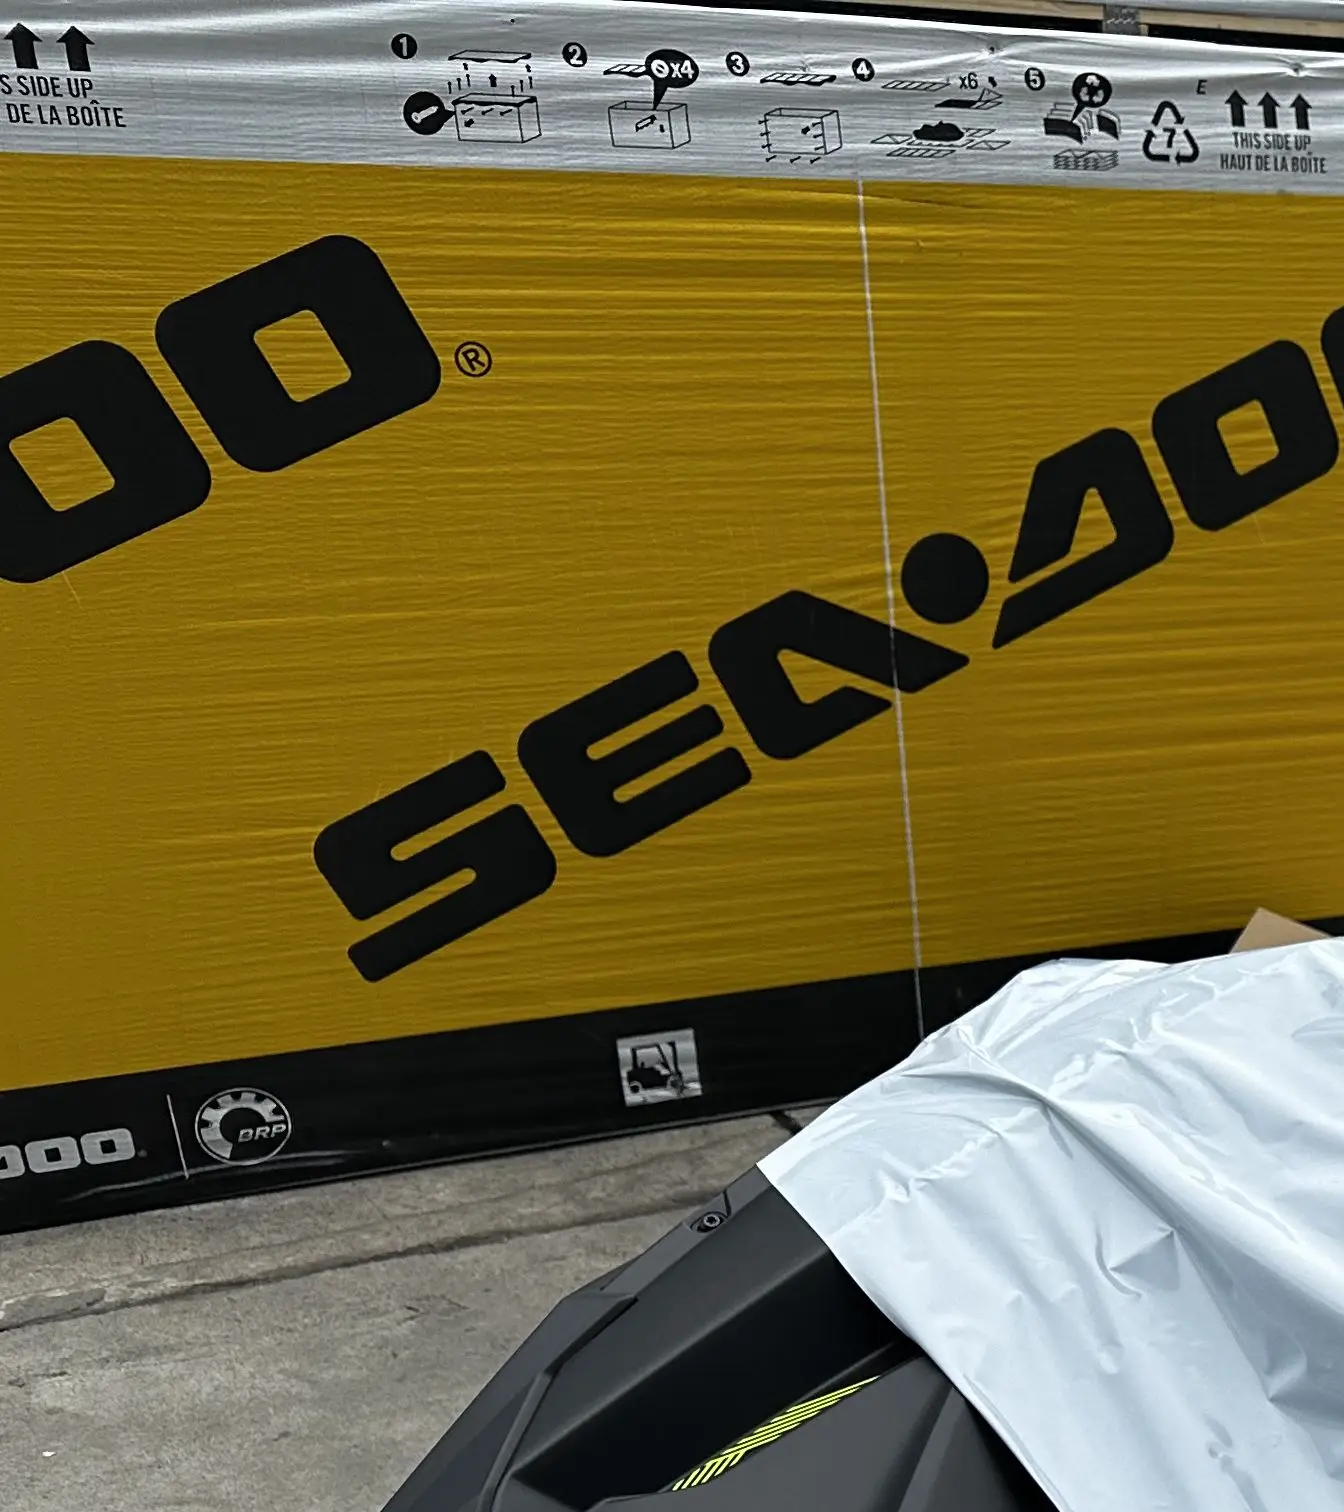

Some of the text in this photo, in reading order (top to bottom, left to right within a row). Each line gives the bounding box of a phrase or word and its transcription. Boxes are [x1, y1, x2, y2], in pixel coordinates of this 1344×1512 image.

[17, 75, 63, 97] SIDE
[67, 78, 93, 98] UP
[959, 74, 979, 89] x6
[6, 100, 126, 127] DE LA BOÎTE
[1163, 128, 1176, 148] 7
[1232, 132, 1311, 151] THIS SIDE UP
[1220, 151, 1327, 173] HAUT DE LA BOÎTE
[237, 1123, 287, 1143] BRP
